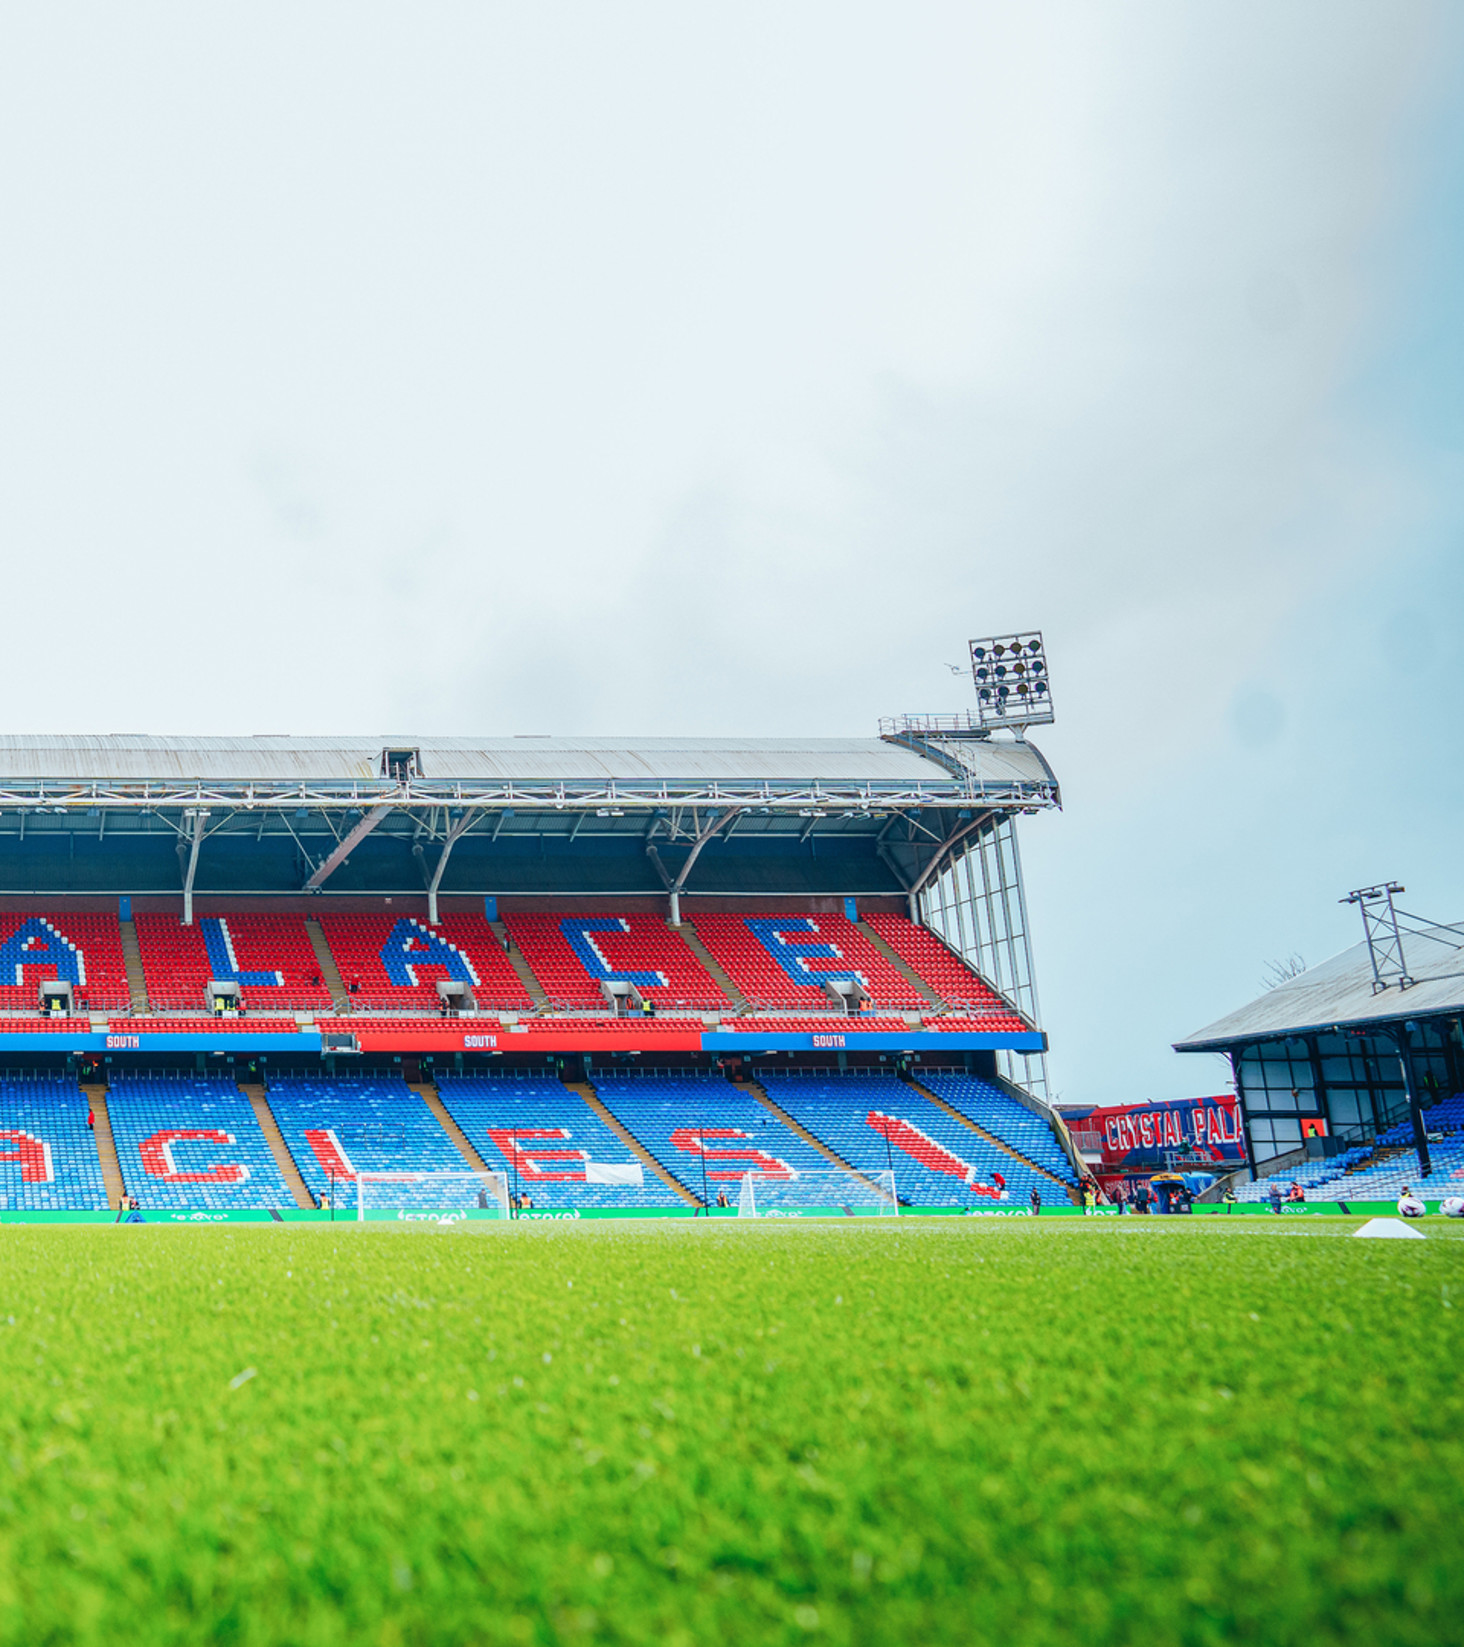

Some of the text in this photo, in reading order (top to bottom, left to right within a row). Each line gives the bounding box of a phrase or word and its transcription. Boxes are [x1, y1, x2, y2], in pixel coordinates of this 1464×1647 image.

[106, 1035, 140, 1049] SOUTH
[464, 1034, 497, 1049] SOUTH
[812, 1034, 846, 1048] SOUTH
